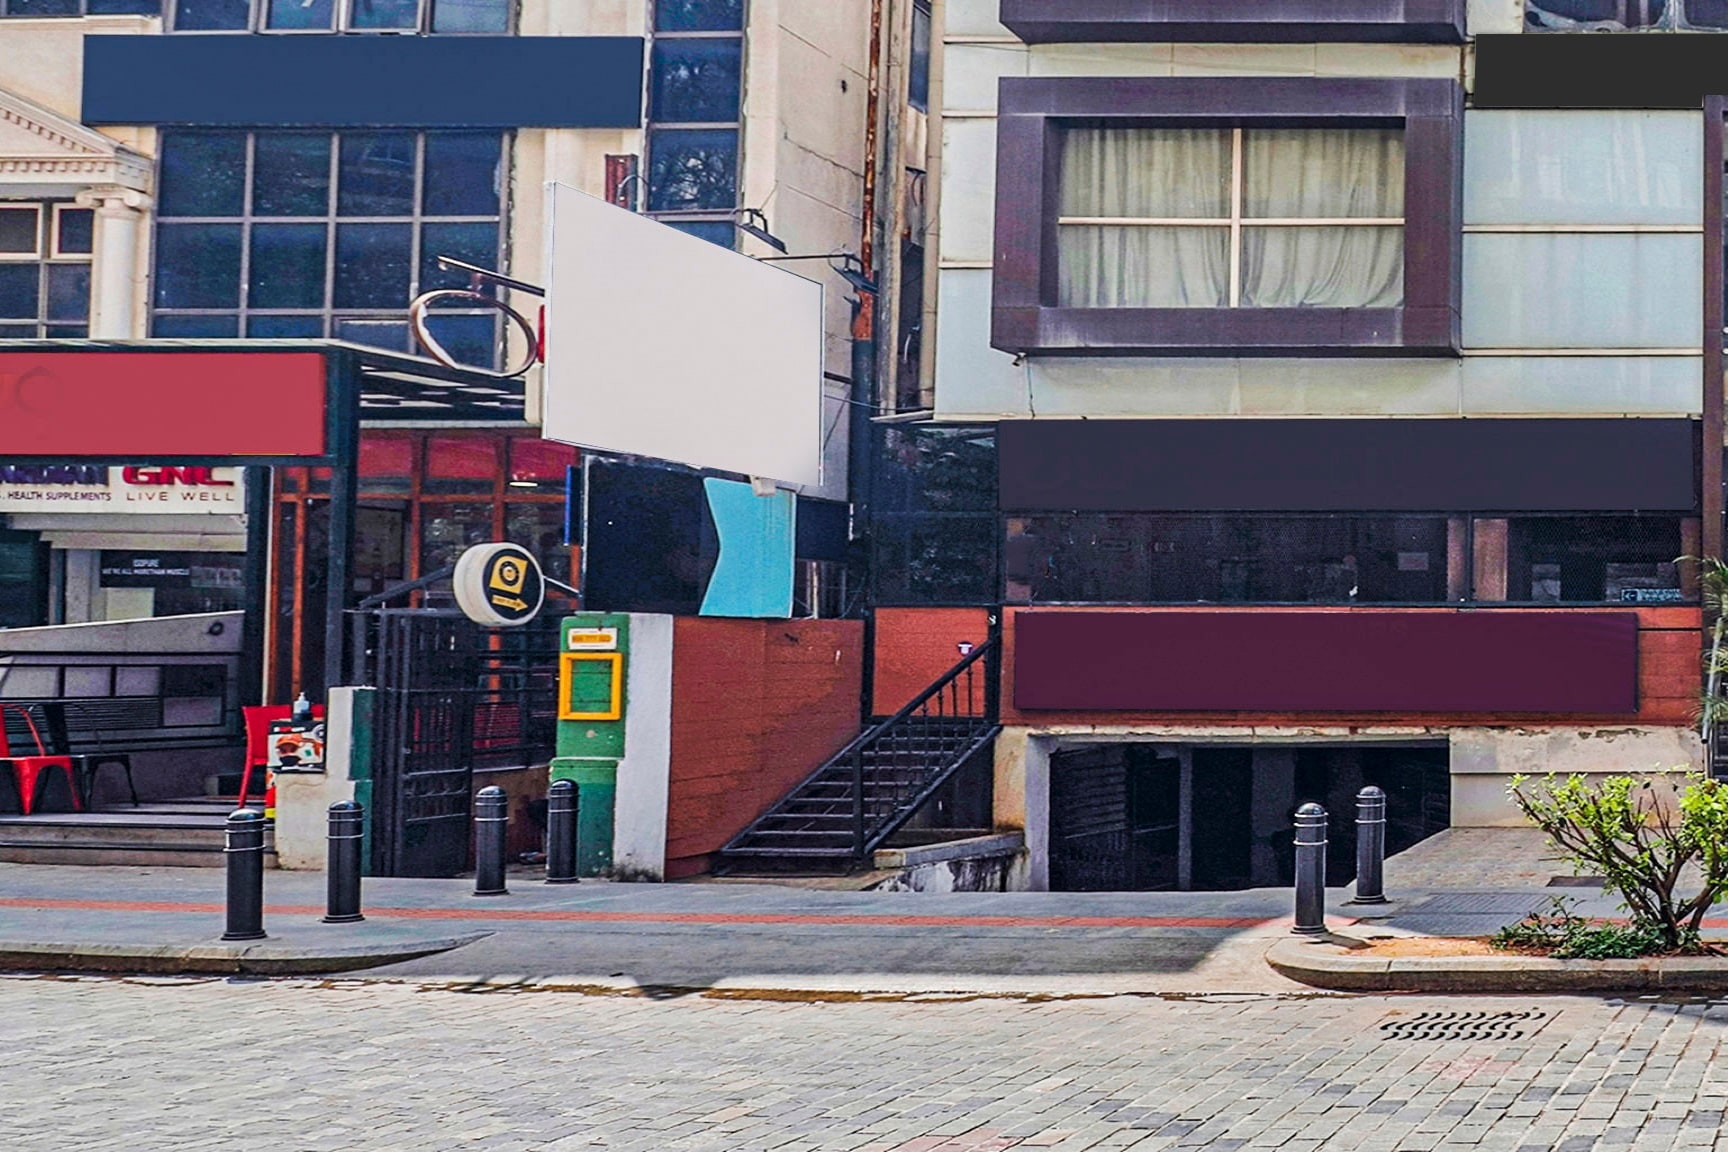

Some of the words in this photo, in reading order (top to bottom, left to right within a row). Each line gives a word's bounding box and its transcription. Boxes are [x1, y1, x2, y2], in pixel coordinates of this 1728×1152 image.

[122, 465, 234, 487] GNC
[8, 491, 42, 500] HEALTH
[46, 491, 112, 501] SUPPLEMENTS
[126, 491, 169, 502] LIVE
[182, 491, 235, 502] WELL
